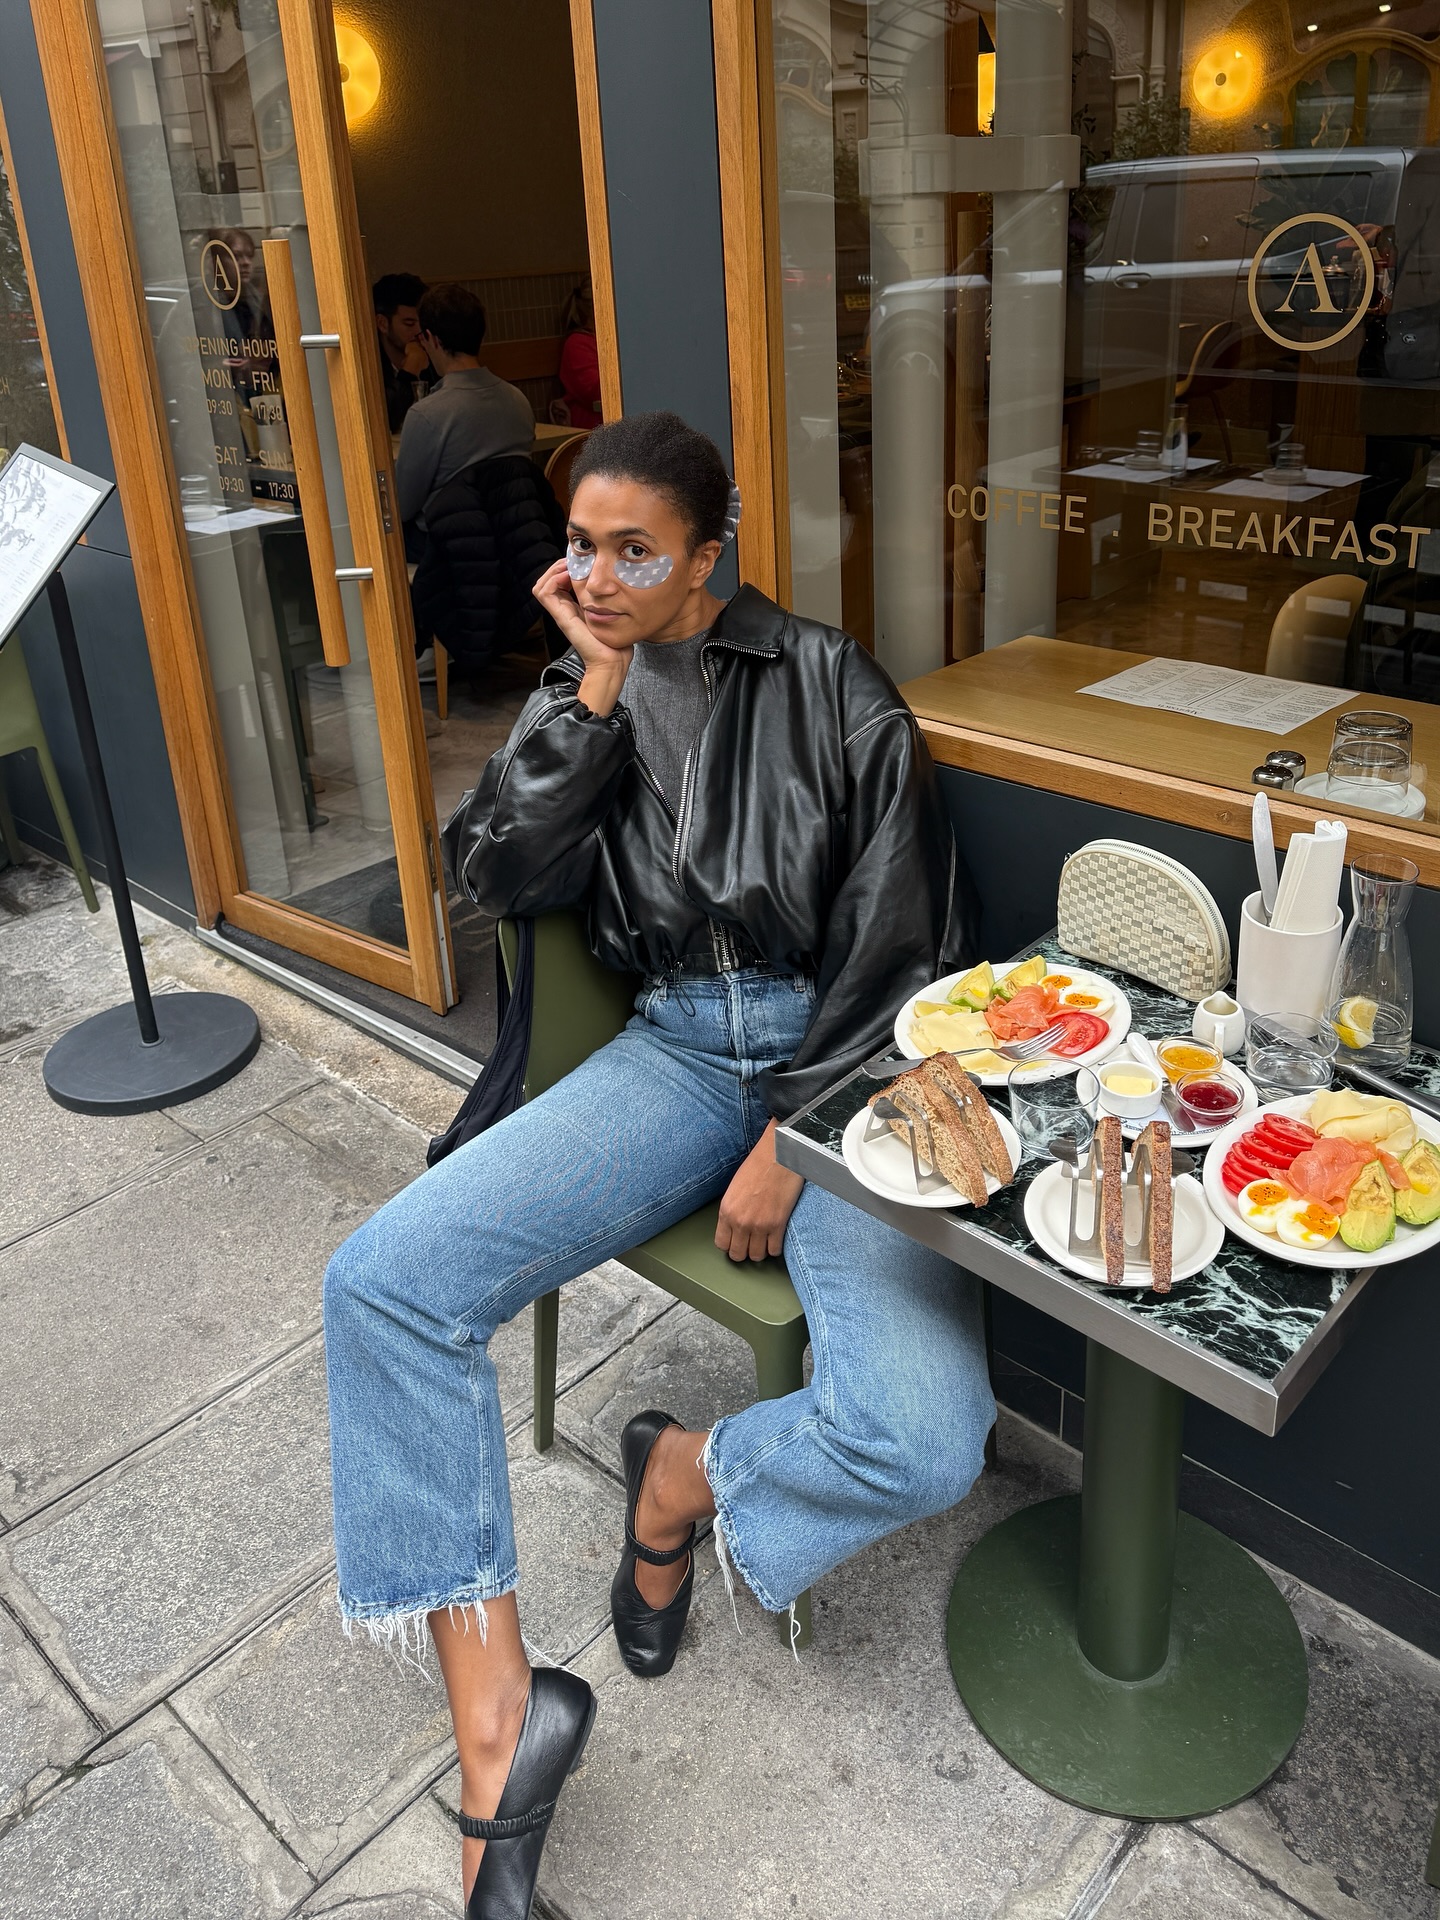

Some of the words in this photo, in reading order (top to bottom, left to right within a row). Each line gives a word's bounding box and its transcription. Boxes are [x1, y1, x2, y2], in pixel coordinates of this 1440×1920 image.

[212, 254, 234, 291] A
[1274, 242, 1343, 313] A
[241, 339, 279, 358] HOUR
[201, 369, 236, 389] MON.
[252, 371, 279, 393] FRI.
[206, 399, 233, 416] 09:30
[214, 445, 242, 466] SAT.
[219, 476, 245, 493] 09:30
[268, 482, 295, 499] 17:30
[946, 483, 1088, 534] COFFEE
[1147, 502, 1431, 569] BREAKFAST
